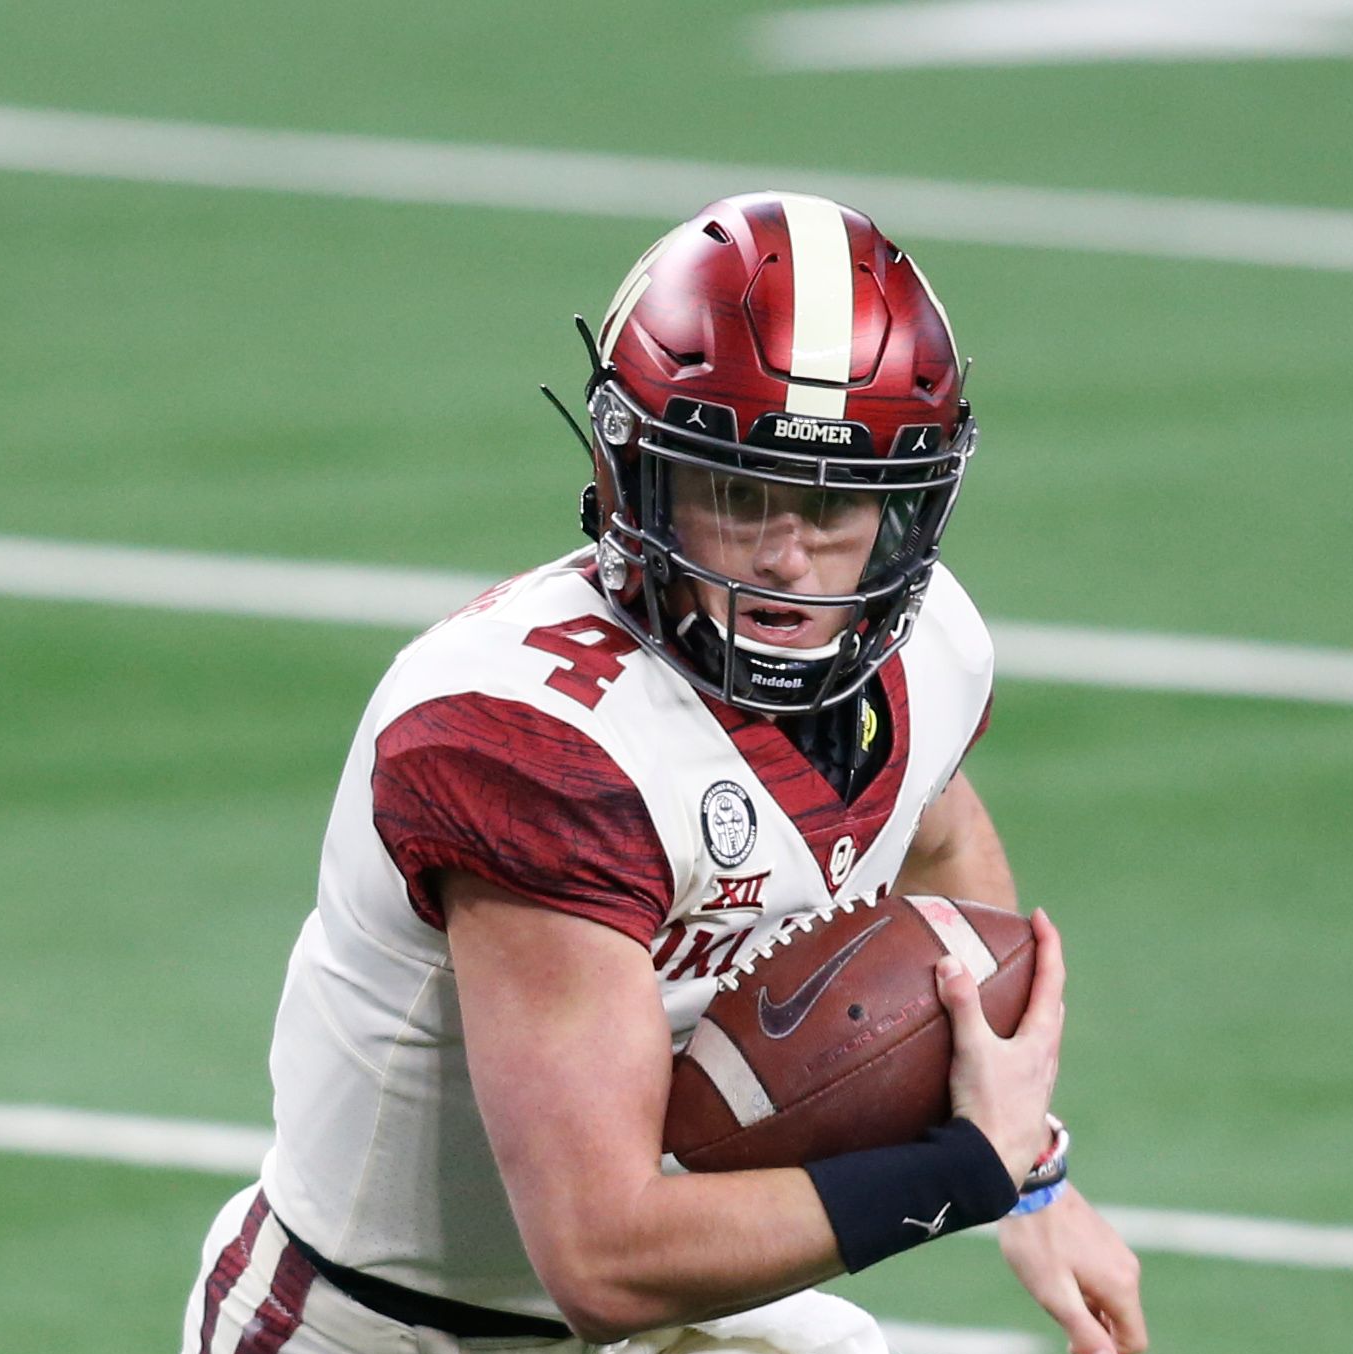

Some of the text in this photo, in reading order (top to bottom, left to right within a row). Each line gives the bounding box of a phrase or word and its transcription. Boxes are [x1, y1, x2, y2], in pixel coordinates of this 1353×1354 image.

[774, 419, 852, 445] BOOMER
[522, 613, 642, 711] 4
[750, 673, 804, 688] Riddell
[701, 870, 771, 911] XII
